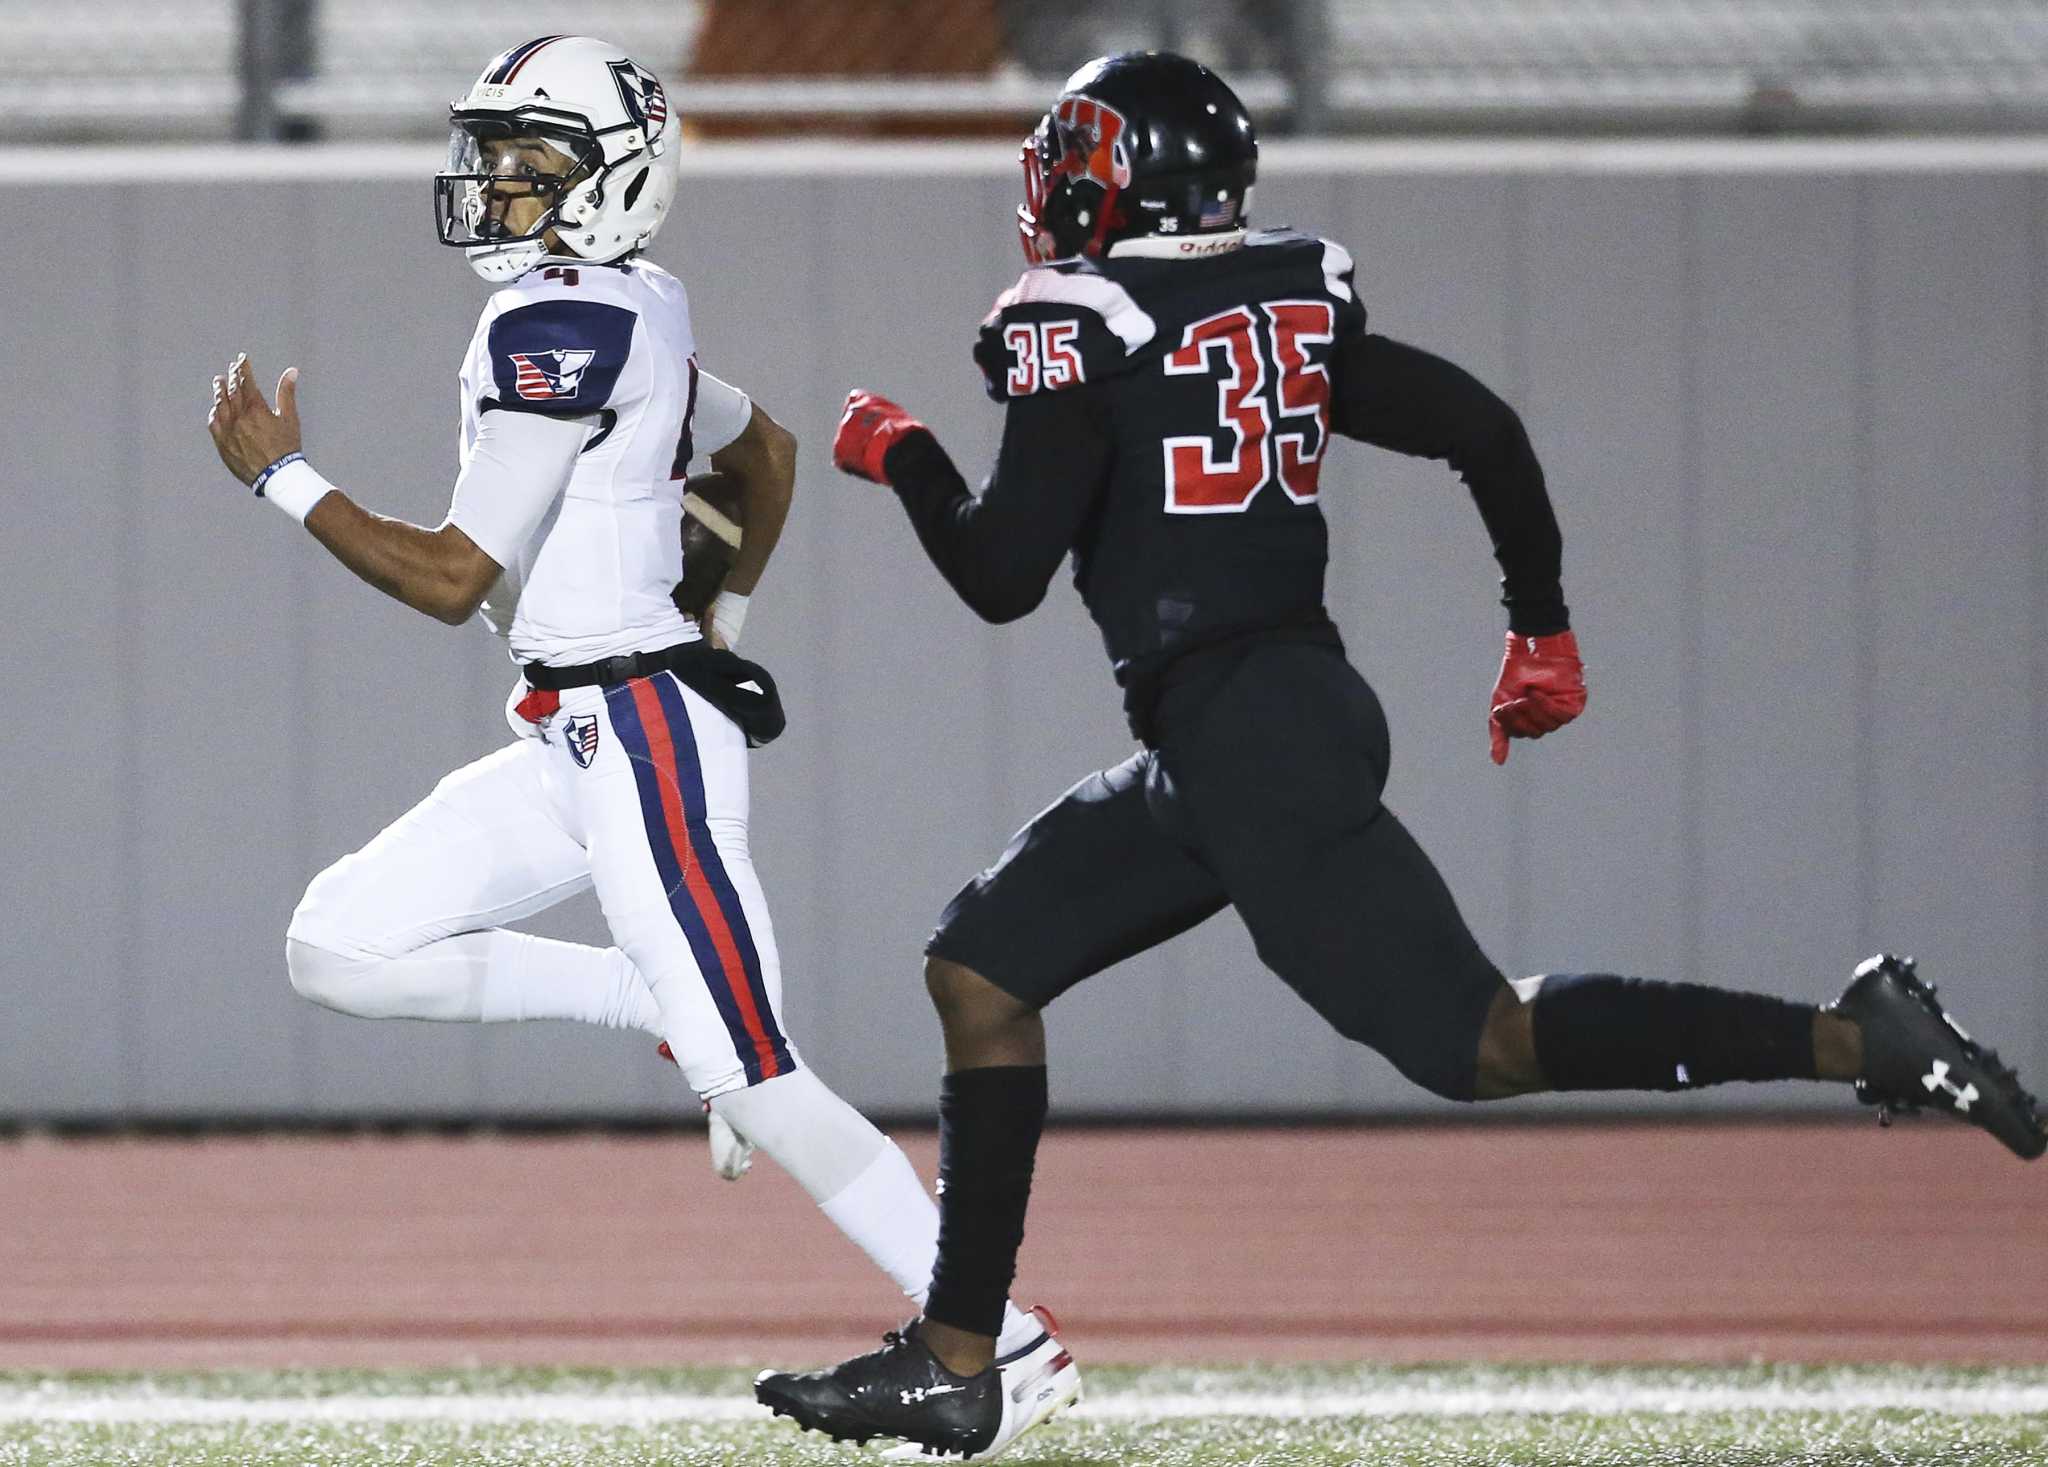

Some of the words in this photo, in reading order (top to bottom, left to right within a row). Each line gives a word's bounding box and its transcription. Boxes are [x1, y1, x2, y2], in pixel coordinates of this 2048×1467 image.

[1159, 216, 1178, 233] 35
[1003, 319, 1086, 396] 35
[1162, 299, 1336, 514] 35
